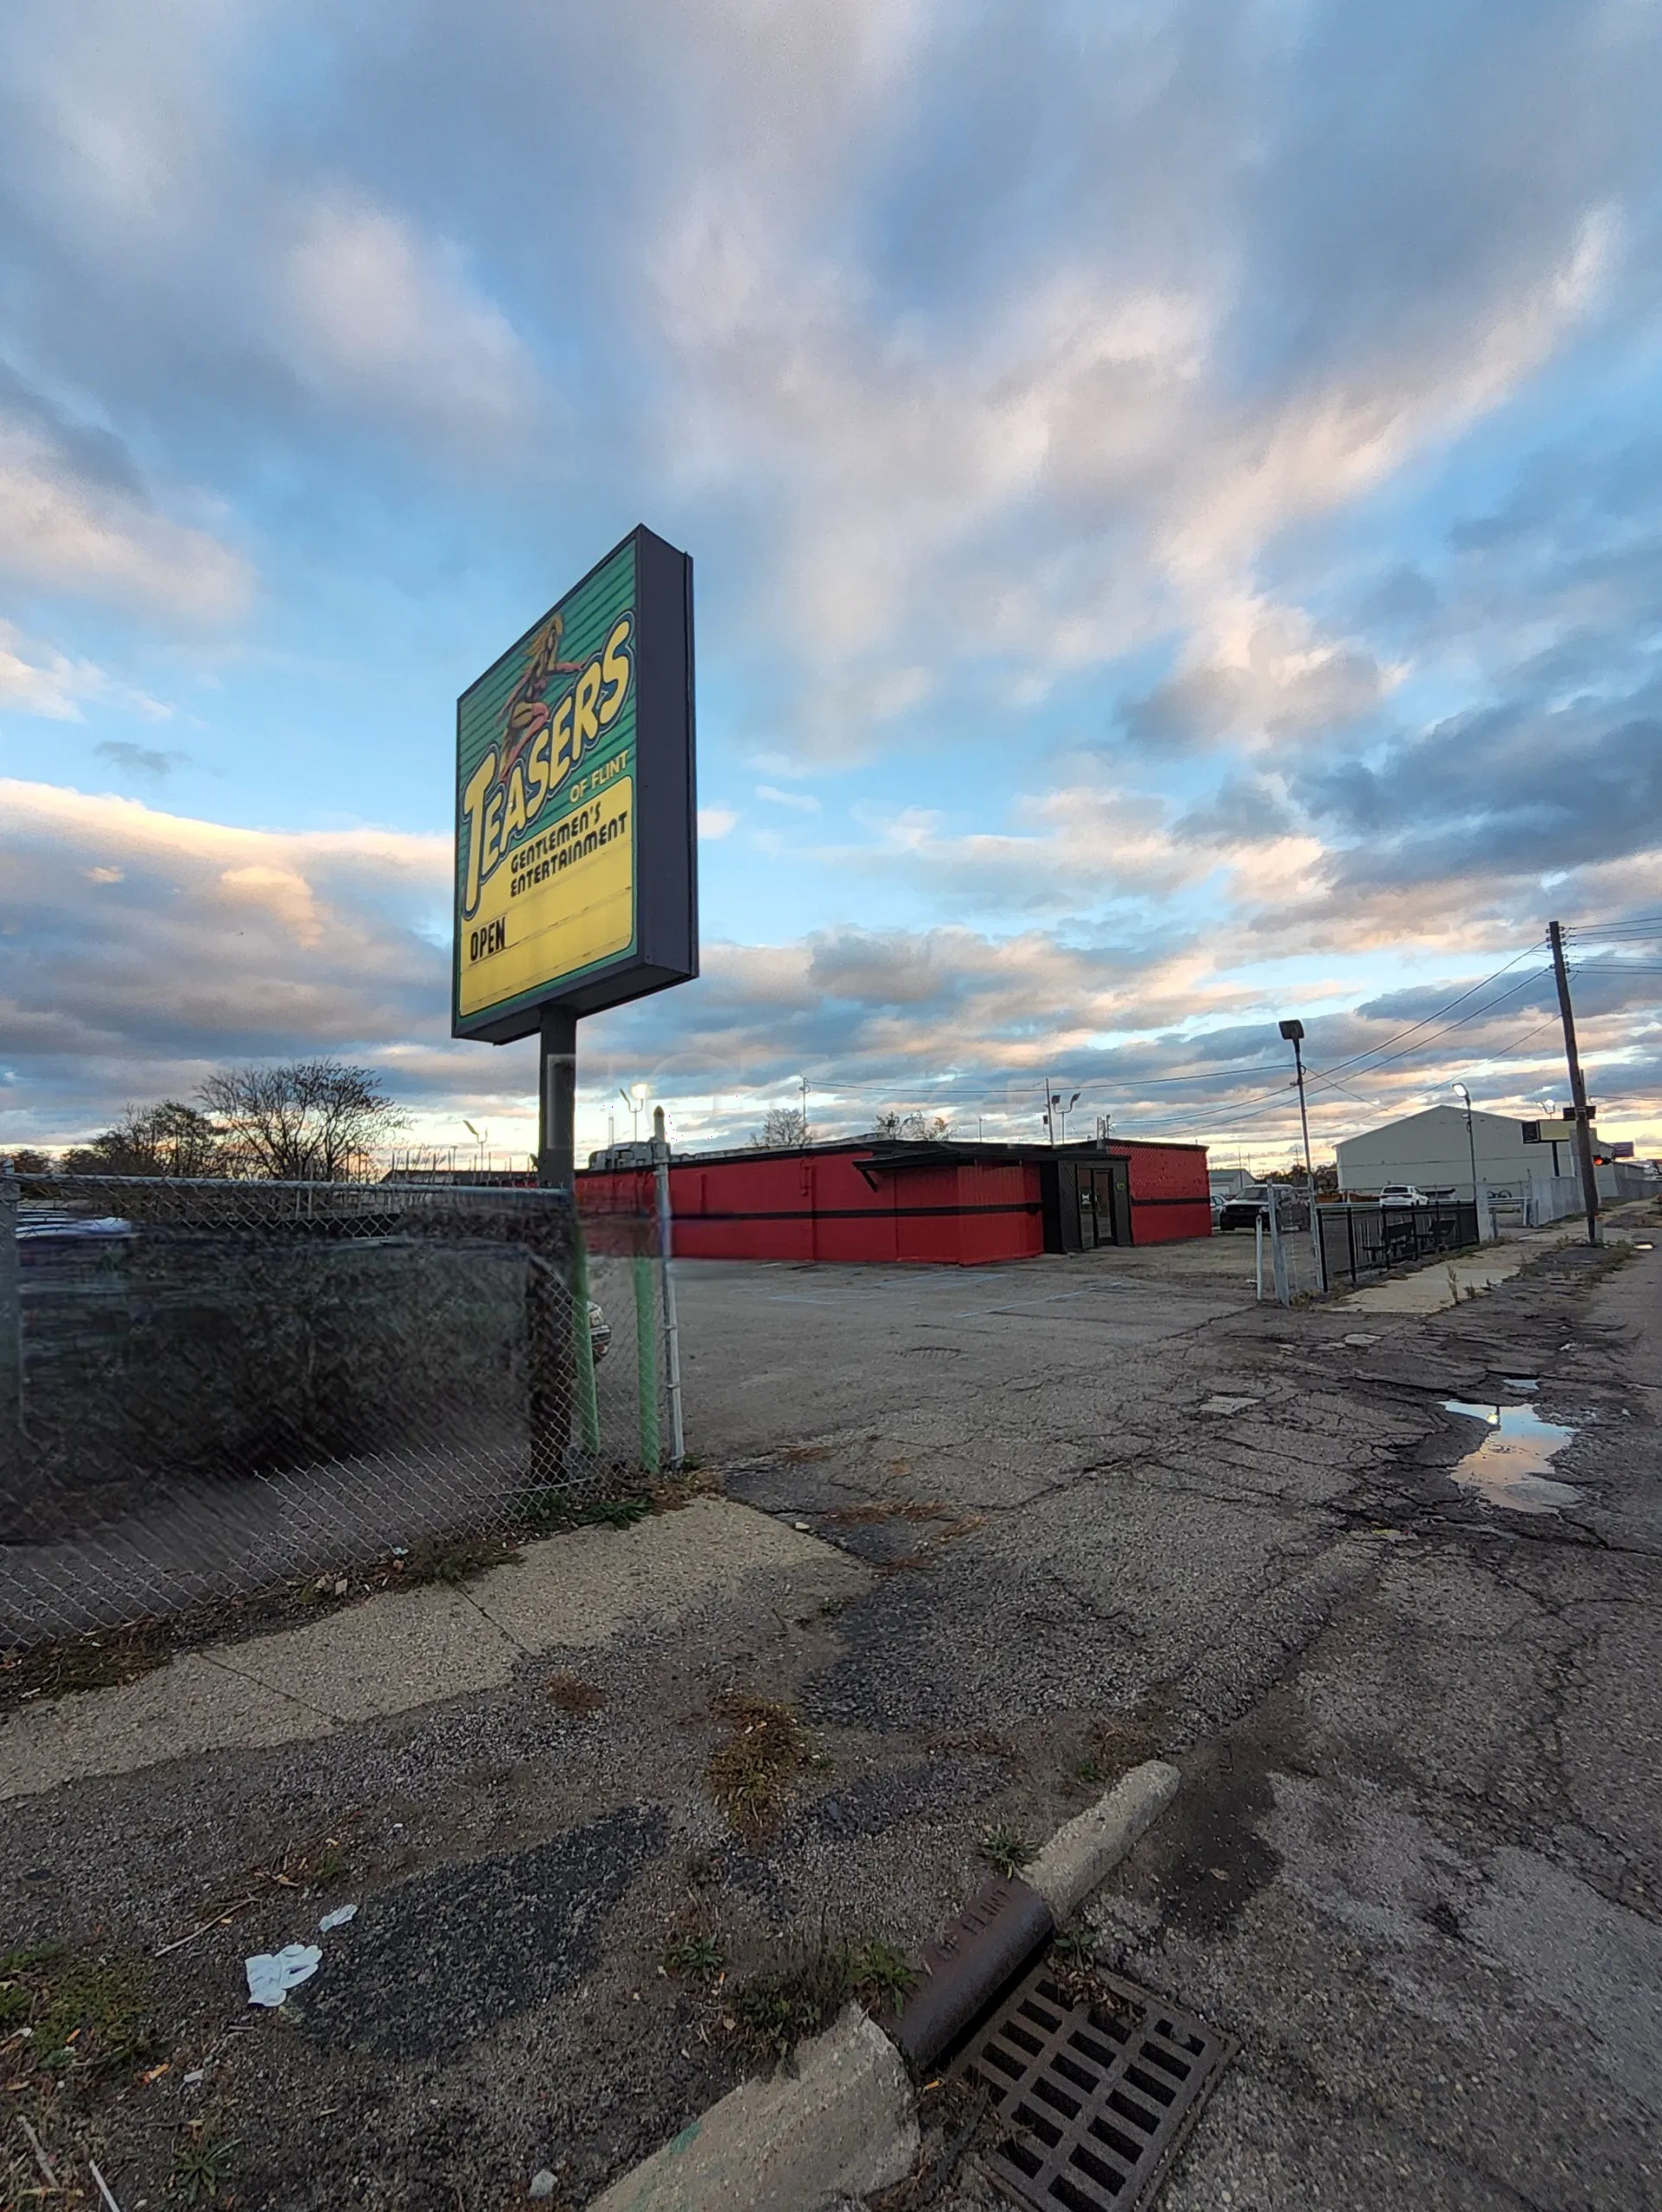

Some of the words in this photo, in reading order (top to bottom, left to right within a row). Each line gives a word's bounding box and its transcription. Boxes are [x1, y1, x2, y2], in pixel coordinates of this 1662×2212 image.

[463, 619, 631, 912] TEASERS
[570, 779, 588, 803] OF
[591, 750, 628, 789] FLINT
[510, 810, 628, 898] ENTERTAINMENT
[511, 801, 602, 874] GENTLEMEN'S
[470, 917, 506, 962] OPEN
